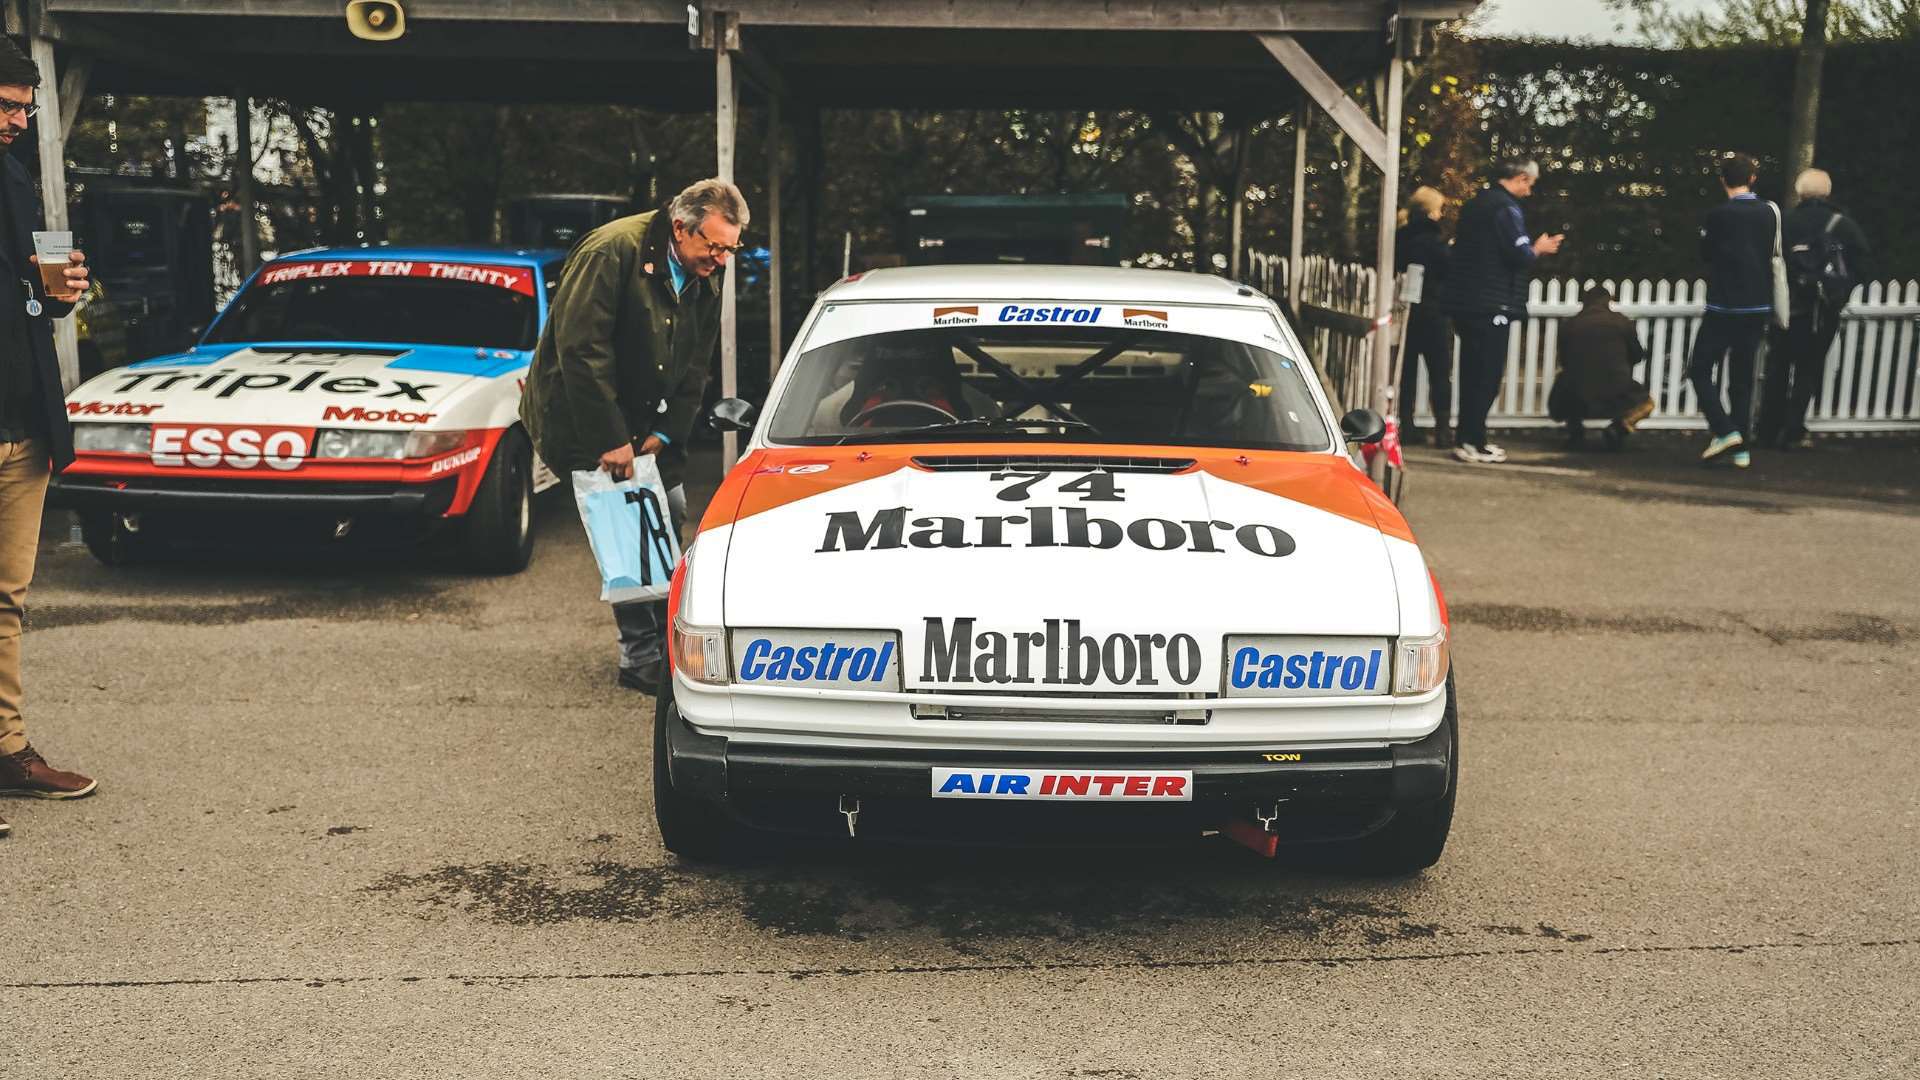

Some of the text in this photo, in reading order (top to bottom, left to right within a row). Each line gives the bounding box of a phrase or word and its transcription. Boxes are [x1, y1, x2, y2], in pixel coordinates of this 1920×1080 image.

[263, 261, 519, 290] TRIPLEX TEN TWENTY
[932, 317, 978, 326] Marlboro
[998, 305, 1102, 324] Castrol
[1123, 318, 1169, 329] Marlboro
[114, 369, 438, 402] Triplex
[65, 401, 164, 416] Motor
[322, 405, 438, 425] Motor
[150, 427, 308, 470] ESSO
[989, 472, 1125, 502] 74
[814, 506, 1297, 557] Marlboro
[740, 638, 895, 684] Castrol
[920, 616, 1202, 686] Marlboro
[1231, 646, 1384, 691] Castrol
[1262, 753, 1302, 762] TOW
[938, 773, 1188, 797] AIR INTER
